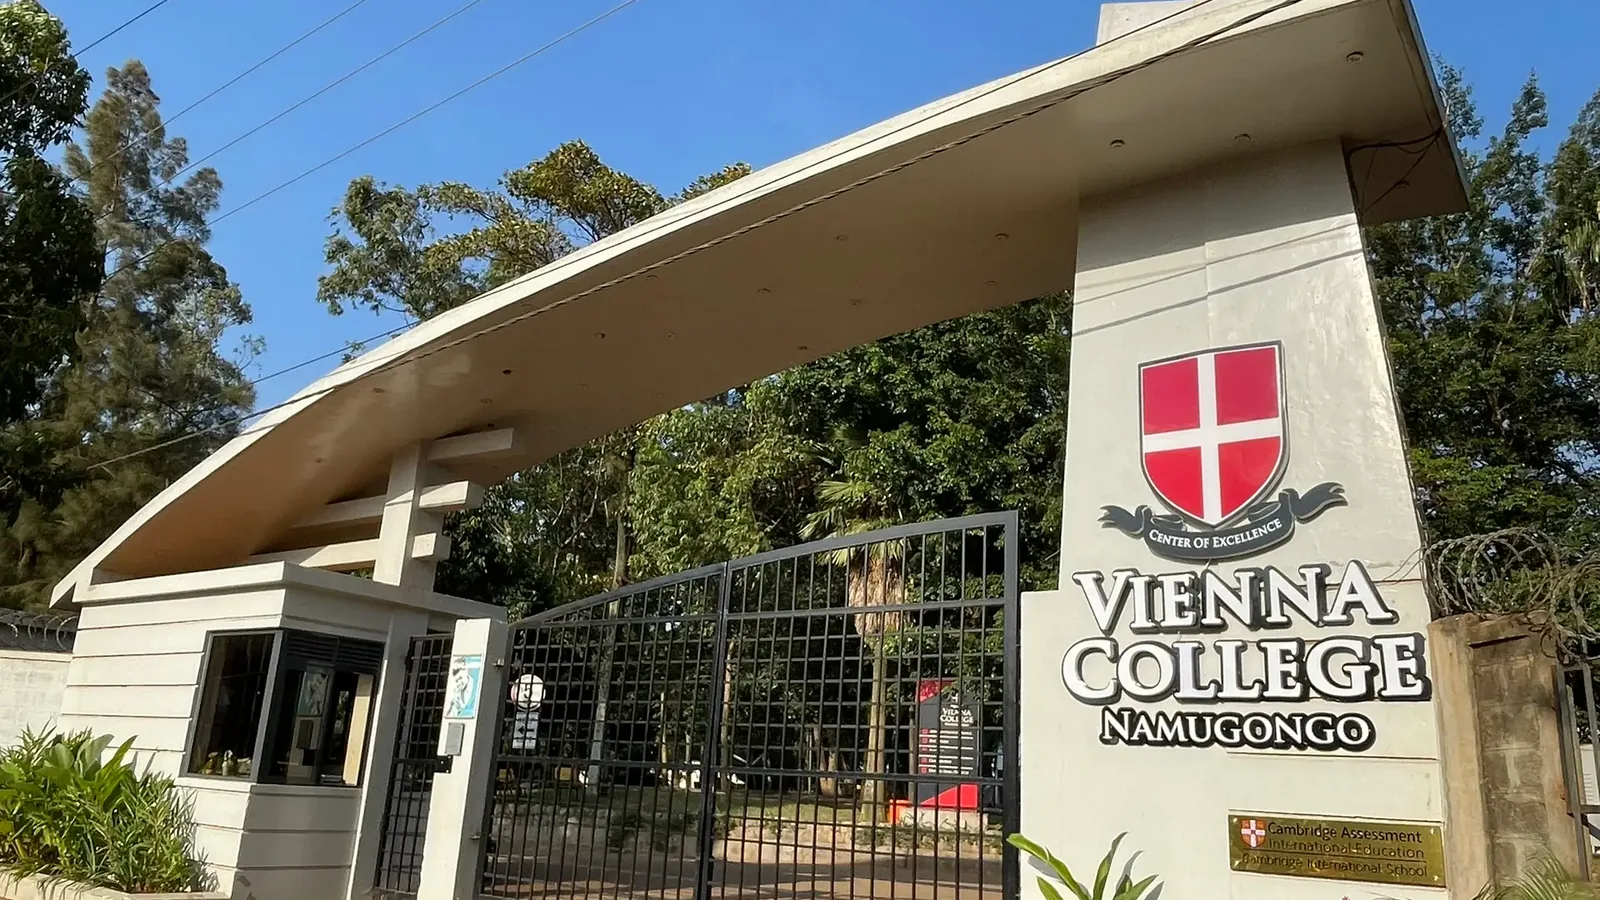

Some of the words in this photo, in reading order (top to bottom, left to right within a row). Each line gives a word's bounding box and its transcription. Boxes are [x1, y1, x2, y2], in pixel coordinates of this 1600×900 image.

[1149, 529, 1192, 549] CENTER
[1193, 537, 1210, 549] OF
[1212, 518, 1283, 548] EXCELLENCE
[1072, 560, 1399, 634] VIENNA
[1062, 634, 1431, 704] COLLEGE
[1100, 706, 1377, 749] NAMUGONGO
[1268, 821, 1337, 841] Cambridge
[1341, 826, 1423, 843] Assessment
[1269, 838, 1351, 855] International
[1355, 842, 1425, 859] Education
[1242, 852, 1303, 869] Cambridge
[1307, 858, 1381, 874] International
[1386, 863, 1428, 877] School
